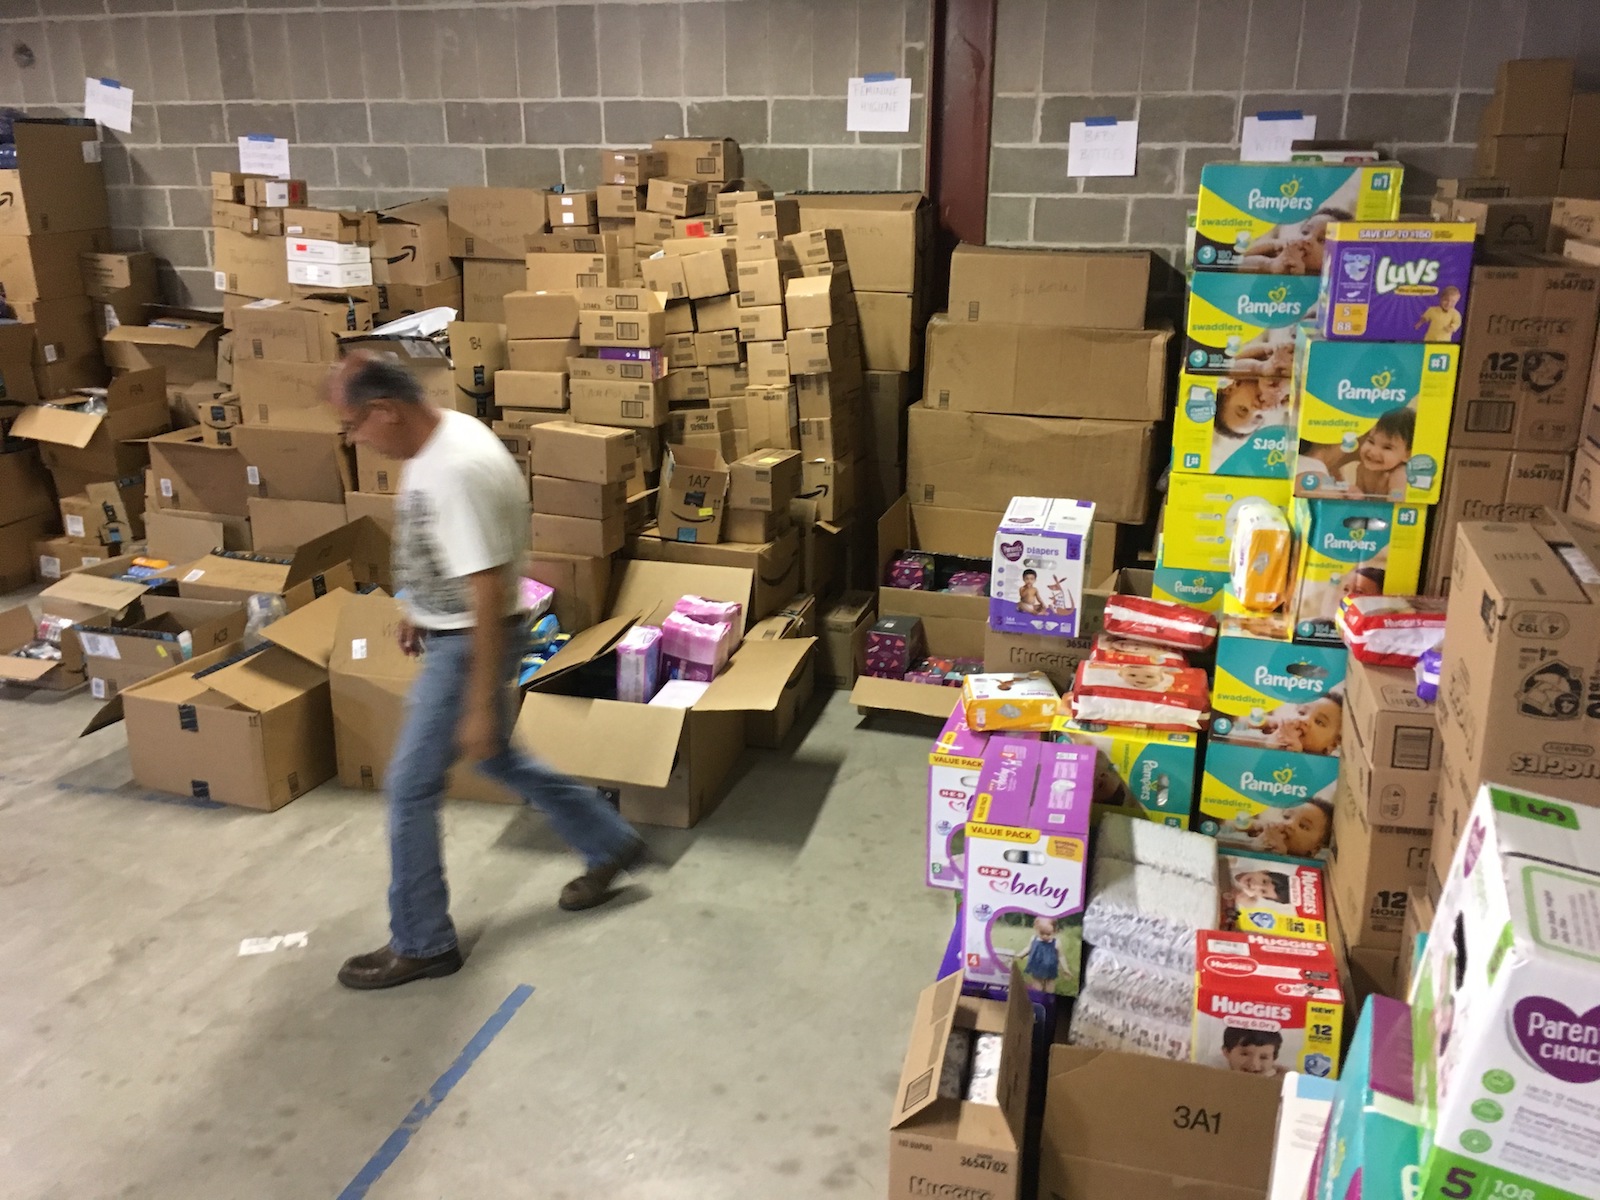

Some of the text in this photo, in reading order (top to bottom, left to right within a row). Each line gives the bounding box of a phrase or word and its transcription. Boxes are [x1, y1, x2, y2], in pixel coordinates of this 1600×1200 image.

[1373, 175, 1389, 189] #1
[1248, 188, 1313, 213] Pampers
[1201, 218, 1253, 227] swaddlers
[1359, 230, 1382, 239] SAVE
[1383, 230, 1395, 239] UP
[1397, 230, 1409, 239] TO
[1203, 246, 1212, 259] 3
[1545, 278, 1595, 292] 3654702
[1237, 294, 1302, 317] Pampers
[1192, 323, 1243, 331] swaddlers
[1194, 351, 1203, 363] 3
[1431, 356, 1447, 370] #1
[1489, 352, 1519, 371] 12
[1479, 372, 1517, 381] HOUR
[1337, 379, 1406, 403] Pampers
[1308, 419, 1359, 428] swaddlers
[1253, 437, 1287, 451] pers
[687, 474, 711, 489] 1A7
[1305, 475, 1315, 486] 5
[1517, 468, 1564, 481] 3654702
[1400, 511, 1418, 524] #1
[1324, 534, 1377, 552] Pampers
[1026, 546, 1059, 557] Diapers
[1174, 580, 1213, 596] Pampers
[1302, 623, 1310, 633] 4
[1517, 622, 1538, 633] 192
[1255, 666, 1324, 692] Pampers
[1217, 693, 1266, 705] swaddlers
[1219, 718, 1227, 730] 3
[933, 755, 983, 767] VALUE PACK
[1511, 753, 1600, 779] UGGIES
[1140, 759, 1159, 801] Pampers
[1240, 771, 1307, 797] Pampers
[1204, 797, 1252, 809] swaddlers
[1526, 801, 1567, 823] 5
[971, 826, 1032, 840] VALUE PACK
[1205, 822, 1214, 832] 3
[980, 868, 1009, 877] H-E-B
[1010, 872, 1070, 908] baby
[1301, 870, 1317, 915] HUGGIES
[1378, 890, 1408, 909] 12
[1294, 921, 1305, 933] 12
[1248, 935, 1326, 950] HUGGIES
[968, 954, 978, 966] 4
[1211, 995, 1292, 1020] HUGGIES
[1311, 1007, 1335, 1015] NEW!
[1227, 1018, 1250, 1028] Snug
[1258, 1020, 1276, 1031] Dry
[1313, 1024, 1332, 1036] 12
[1528, 1012, 1600, 1045] Paren
[1540, 1043, 1600, 1066] CHOIC
[1173, 1105, 1221, 1135] 3A1
[960, 1156, 1008, 1174] 3654702
[1440, 1166, 1476, 1200] 5
